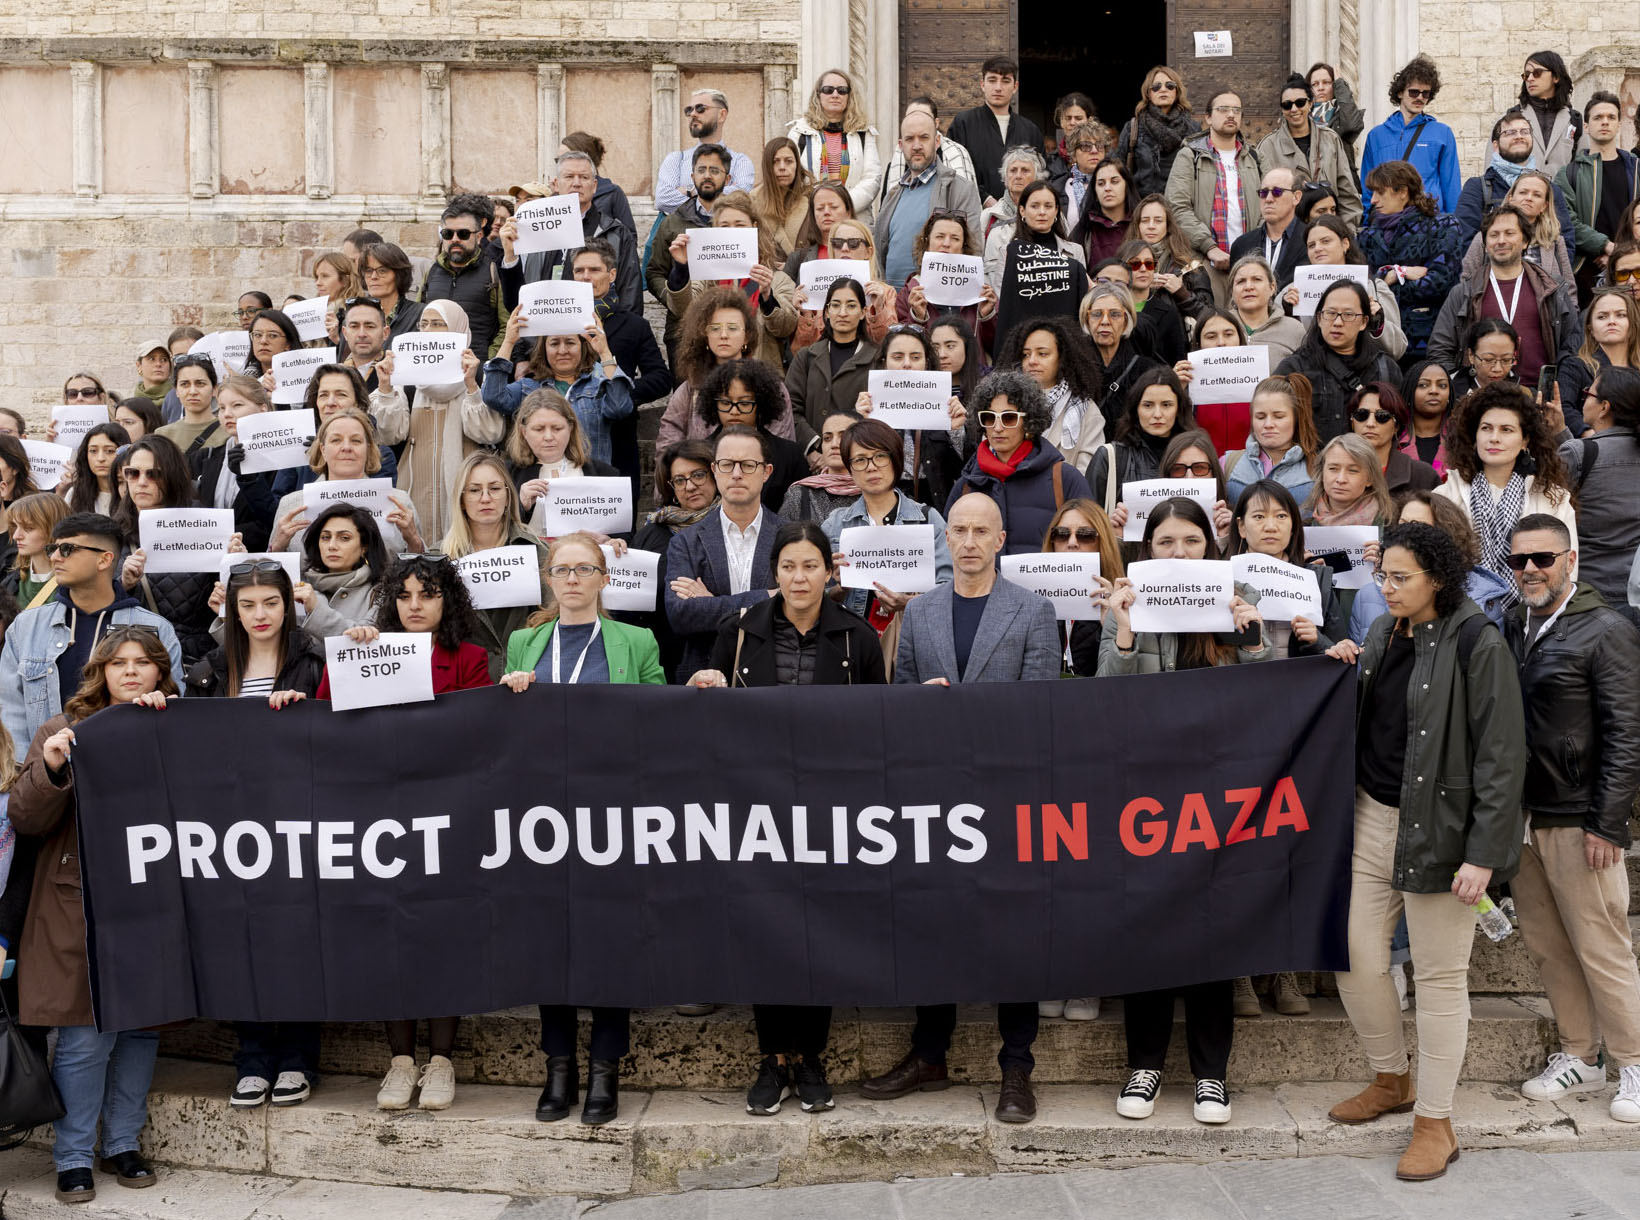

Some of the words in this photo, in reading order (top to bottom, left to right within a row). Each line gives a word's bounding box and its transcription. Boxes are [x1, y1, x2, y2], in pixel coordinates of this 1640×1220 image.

[516, 204, 573, 220] #ThisMust
[531, 219, 562, 232] STOP
[701, 243, 740, 253] #PROTECT
[696, 251, 746, 261] JOURNALISTS
[928, 262, 978, 275] #ThisMust
[941, 275, 969, 287] STOP
[1017, 270, 1070, 283] PALESTINE
[1307, 273, 1355, 281] #LetMediaIn
[1018, 282, 1070, 300] فلسطين
[533, 297, 575, 307] #PROTECT
[291, 309, 316, 319] #PROTECT
[527, 305, 583, 315] JOURNALISTS
[398, 341, 456, 353] #ThisMust
[281, 356, 323, 369] #LetMediaIn
[412, 353, 444, 365] STOP
[1203, 354, 1255, 366] #LetMediaIn
[883, 380, 937, 389] #LetMediaIn
[1200, 375, 1260, 387] #LetMediaOut
[879, 401, 941, 411] #LetMediaOut
[251, 428, 295, 441] #PROTECT
[247, 437, 303, 451] JOURNALISTS
[30, 465, 56, 475] Target
[319, 489, 377, 499] #LetMediaIn
[1140, 487, 1200, 497] #LetMediaIn
[554, 495, 605, 505] Journalists
[560, 505, 617, 517] #NotATarget
[156, 518, 217, 528] #LetMediaIn
[153, 541, 223, 551] #LetMediaOut
[848, 548, 905, 558] Journalists
[460, 555, 525, 570] ThisMust
[855, 560, 918, 570] #NotATarget
[1019, 563, 1083, 574] #LetMediaIn
[471, 570, 511, 583] STOP
[633, 570, 648, 578] are
[1247, 564, 1305, 582] #LetMediaIn
[608, 578, 641, 590] Target
[1139, 583, 1202, 593] Journalists
[1204, 584, 1222, 593] are
[1034, 588, 1088, 597] MediaOut
[1258, 588, 1312, 603] tMediaOut
[1146, 595, 1216, 607] #NotATarget
[336, 643, 417, 663] #ThisMust
[360, 662, 401, 678] STOP
[126, 814, 451, 884] PROTECT
[479, 802, 988, 870] JOURNALISTS
[1016, 802, 1089, 862] IN
[1118, 775, 1310, 857] GAZA
